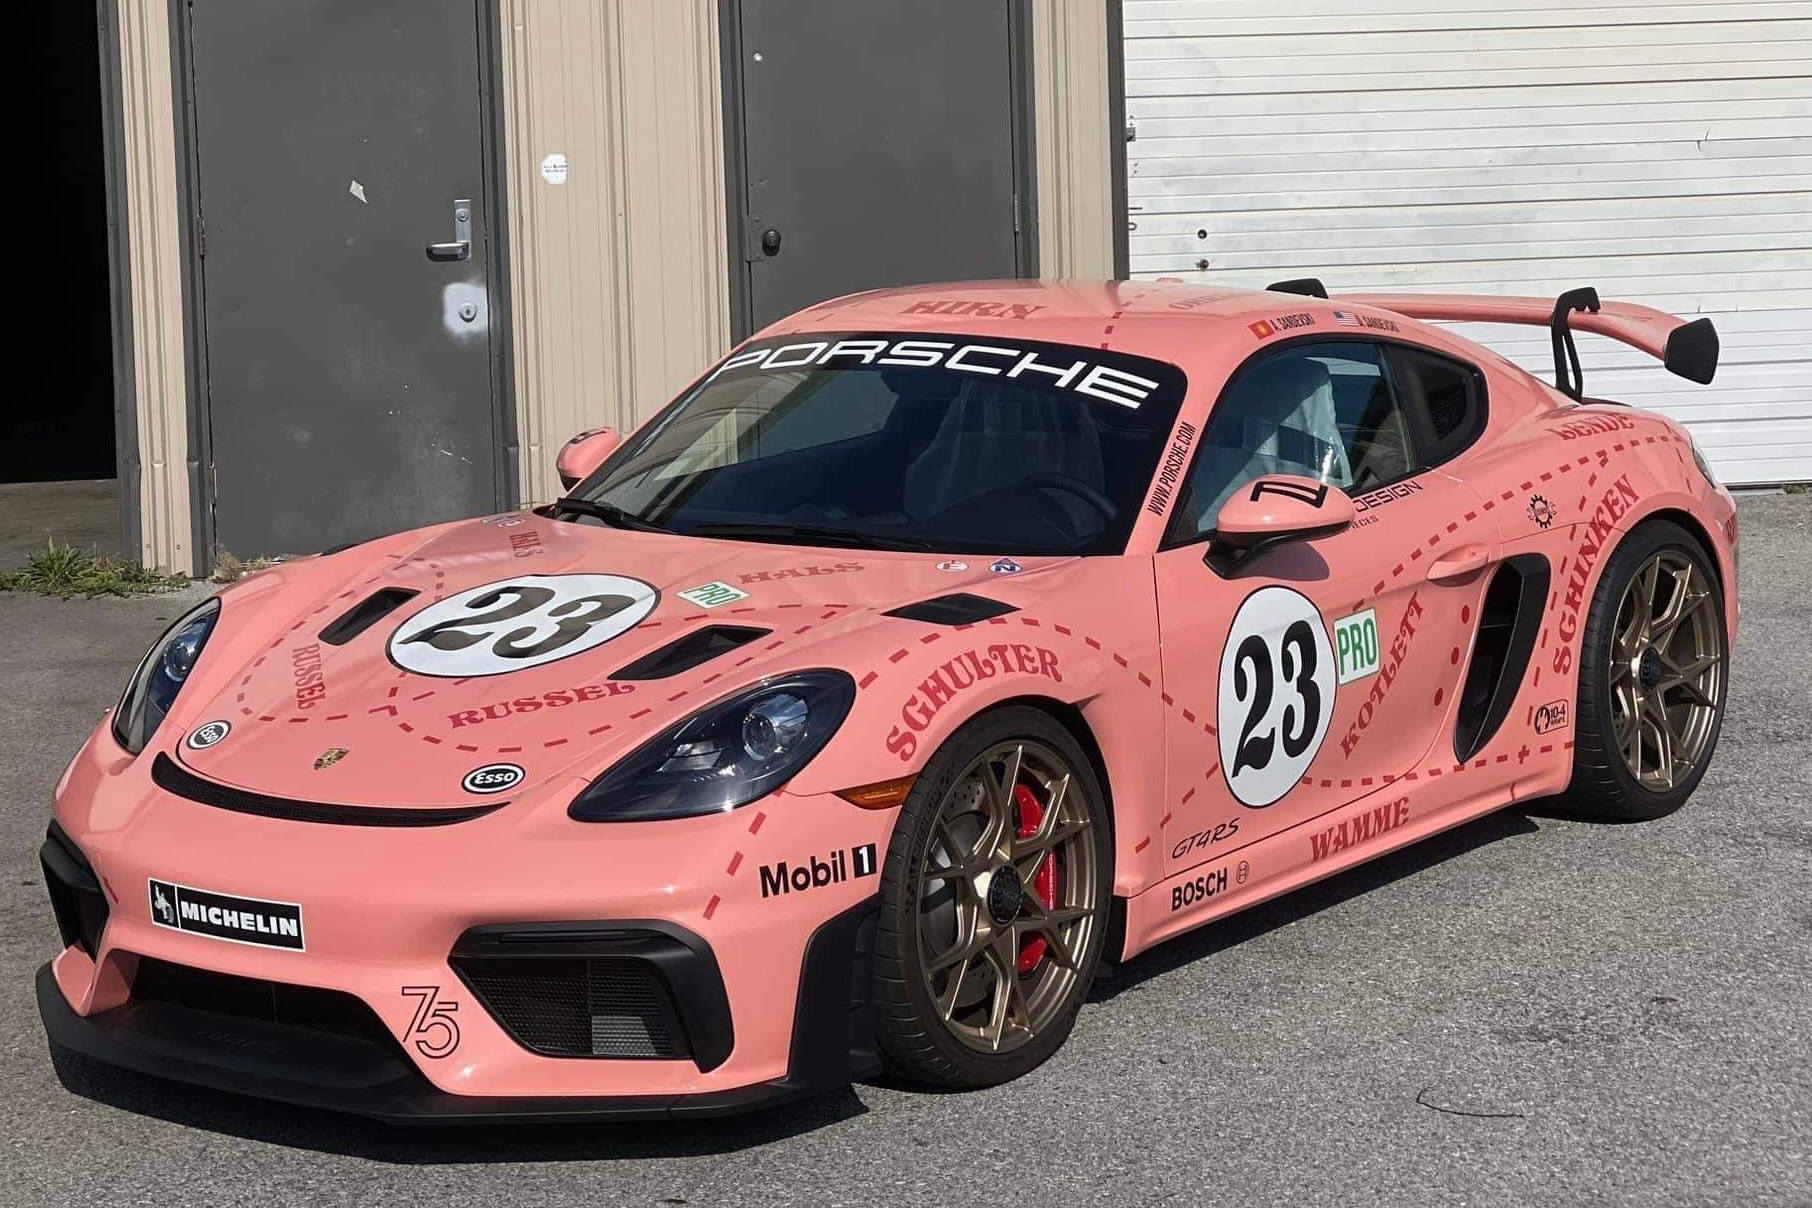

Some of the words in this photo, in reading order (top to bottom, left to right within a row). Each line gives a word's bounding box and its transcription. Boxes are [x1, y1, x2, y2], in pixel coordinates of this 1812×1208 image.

[900, 300, 1047, 319] HIRN
[706, 340, 1160, 409] PORSCHE
[1147, 421, 1197, 517] WWW.PORSCHE.COM
[684, 583, 742, 606] PRO
[738, 561, 865, 585] HALS
[396, 586, 637, 659] 23
[1336, 617, 1377, 676] PRO
[291, 642, 326, 710] RUSSEL
[1231, 619, 1321, 778] 23
[1340, 589, 1423, 760] KOTLETT
[447, 681, 636, 729] RUSSEL
[1171, 816, 1241, 860] GT4RS
[1310, 796, 1410, 862] WAMME
[759, 849, 847, 898] Mobil
[1171, 867, 1228, 912] BOSCH
[180, 899, 299, 937] MICHELIN
[401, 985, 461, 1060] 75
